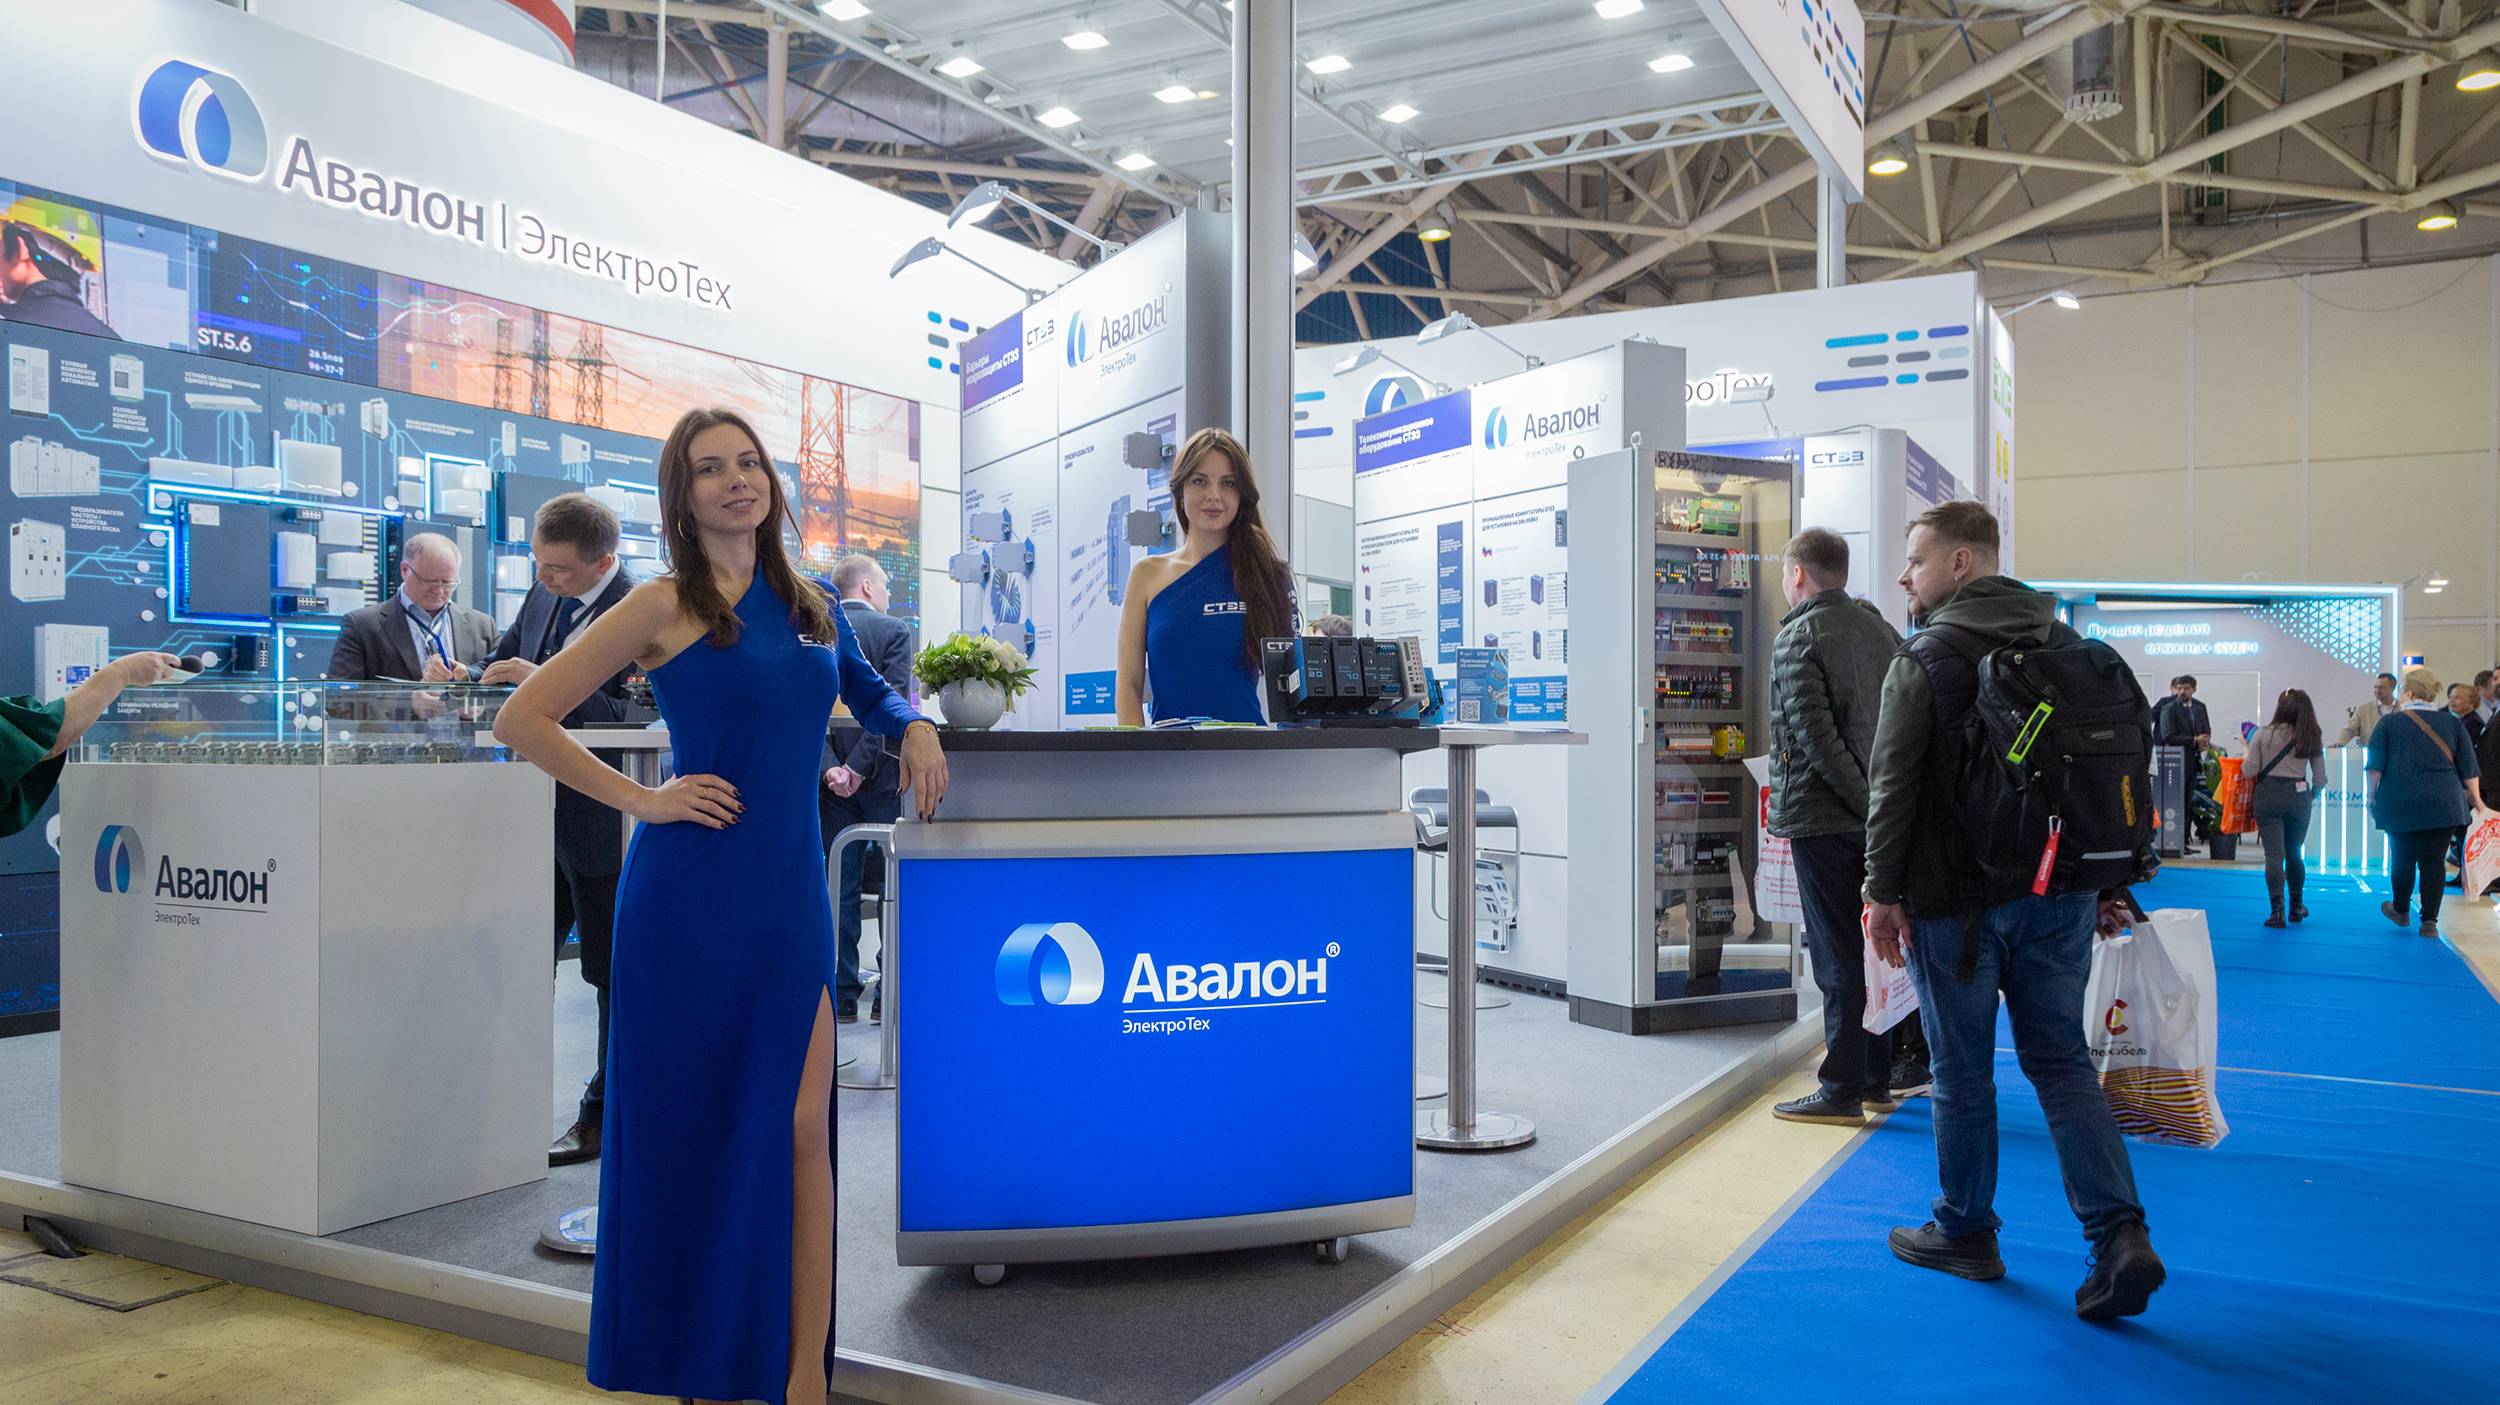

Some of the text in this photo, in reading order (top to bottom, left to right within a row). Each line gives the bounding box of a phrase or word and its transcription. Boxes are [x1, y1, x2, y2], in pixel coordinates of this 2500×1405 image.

[281, 137, 732, 311] Авалон ЭлектроТех
[1100, 295, 1168, 353] Авалон
[197, 327, 252, 353] ST.5.6
[1100, 353, 1137, 378] ЭлектроТех
[1524, 403, 1600, 441] Авалон
[154, 910, 200, 927] ЭлектроТех
[1122, 1016, 1210, 1036] ЭлектроТех
